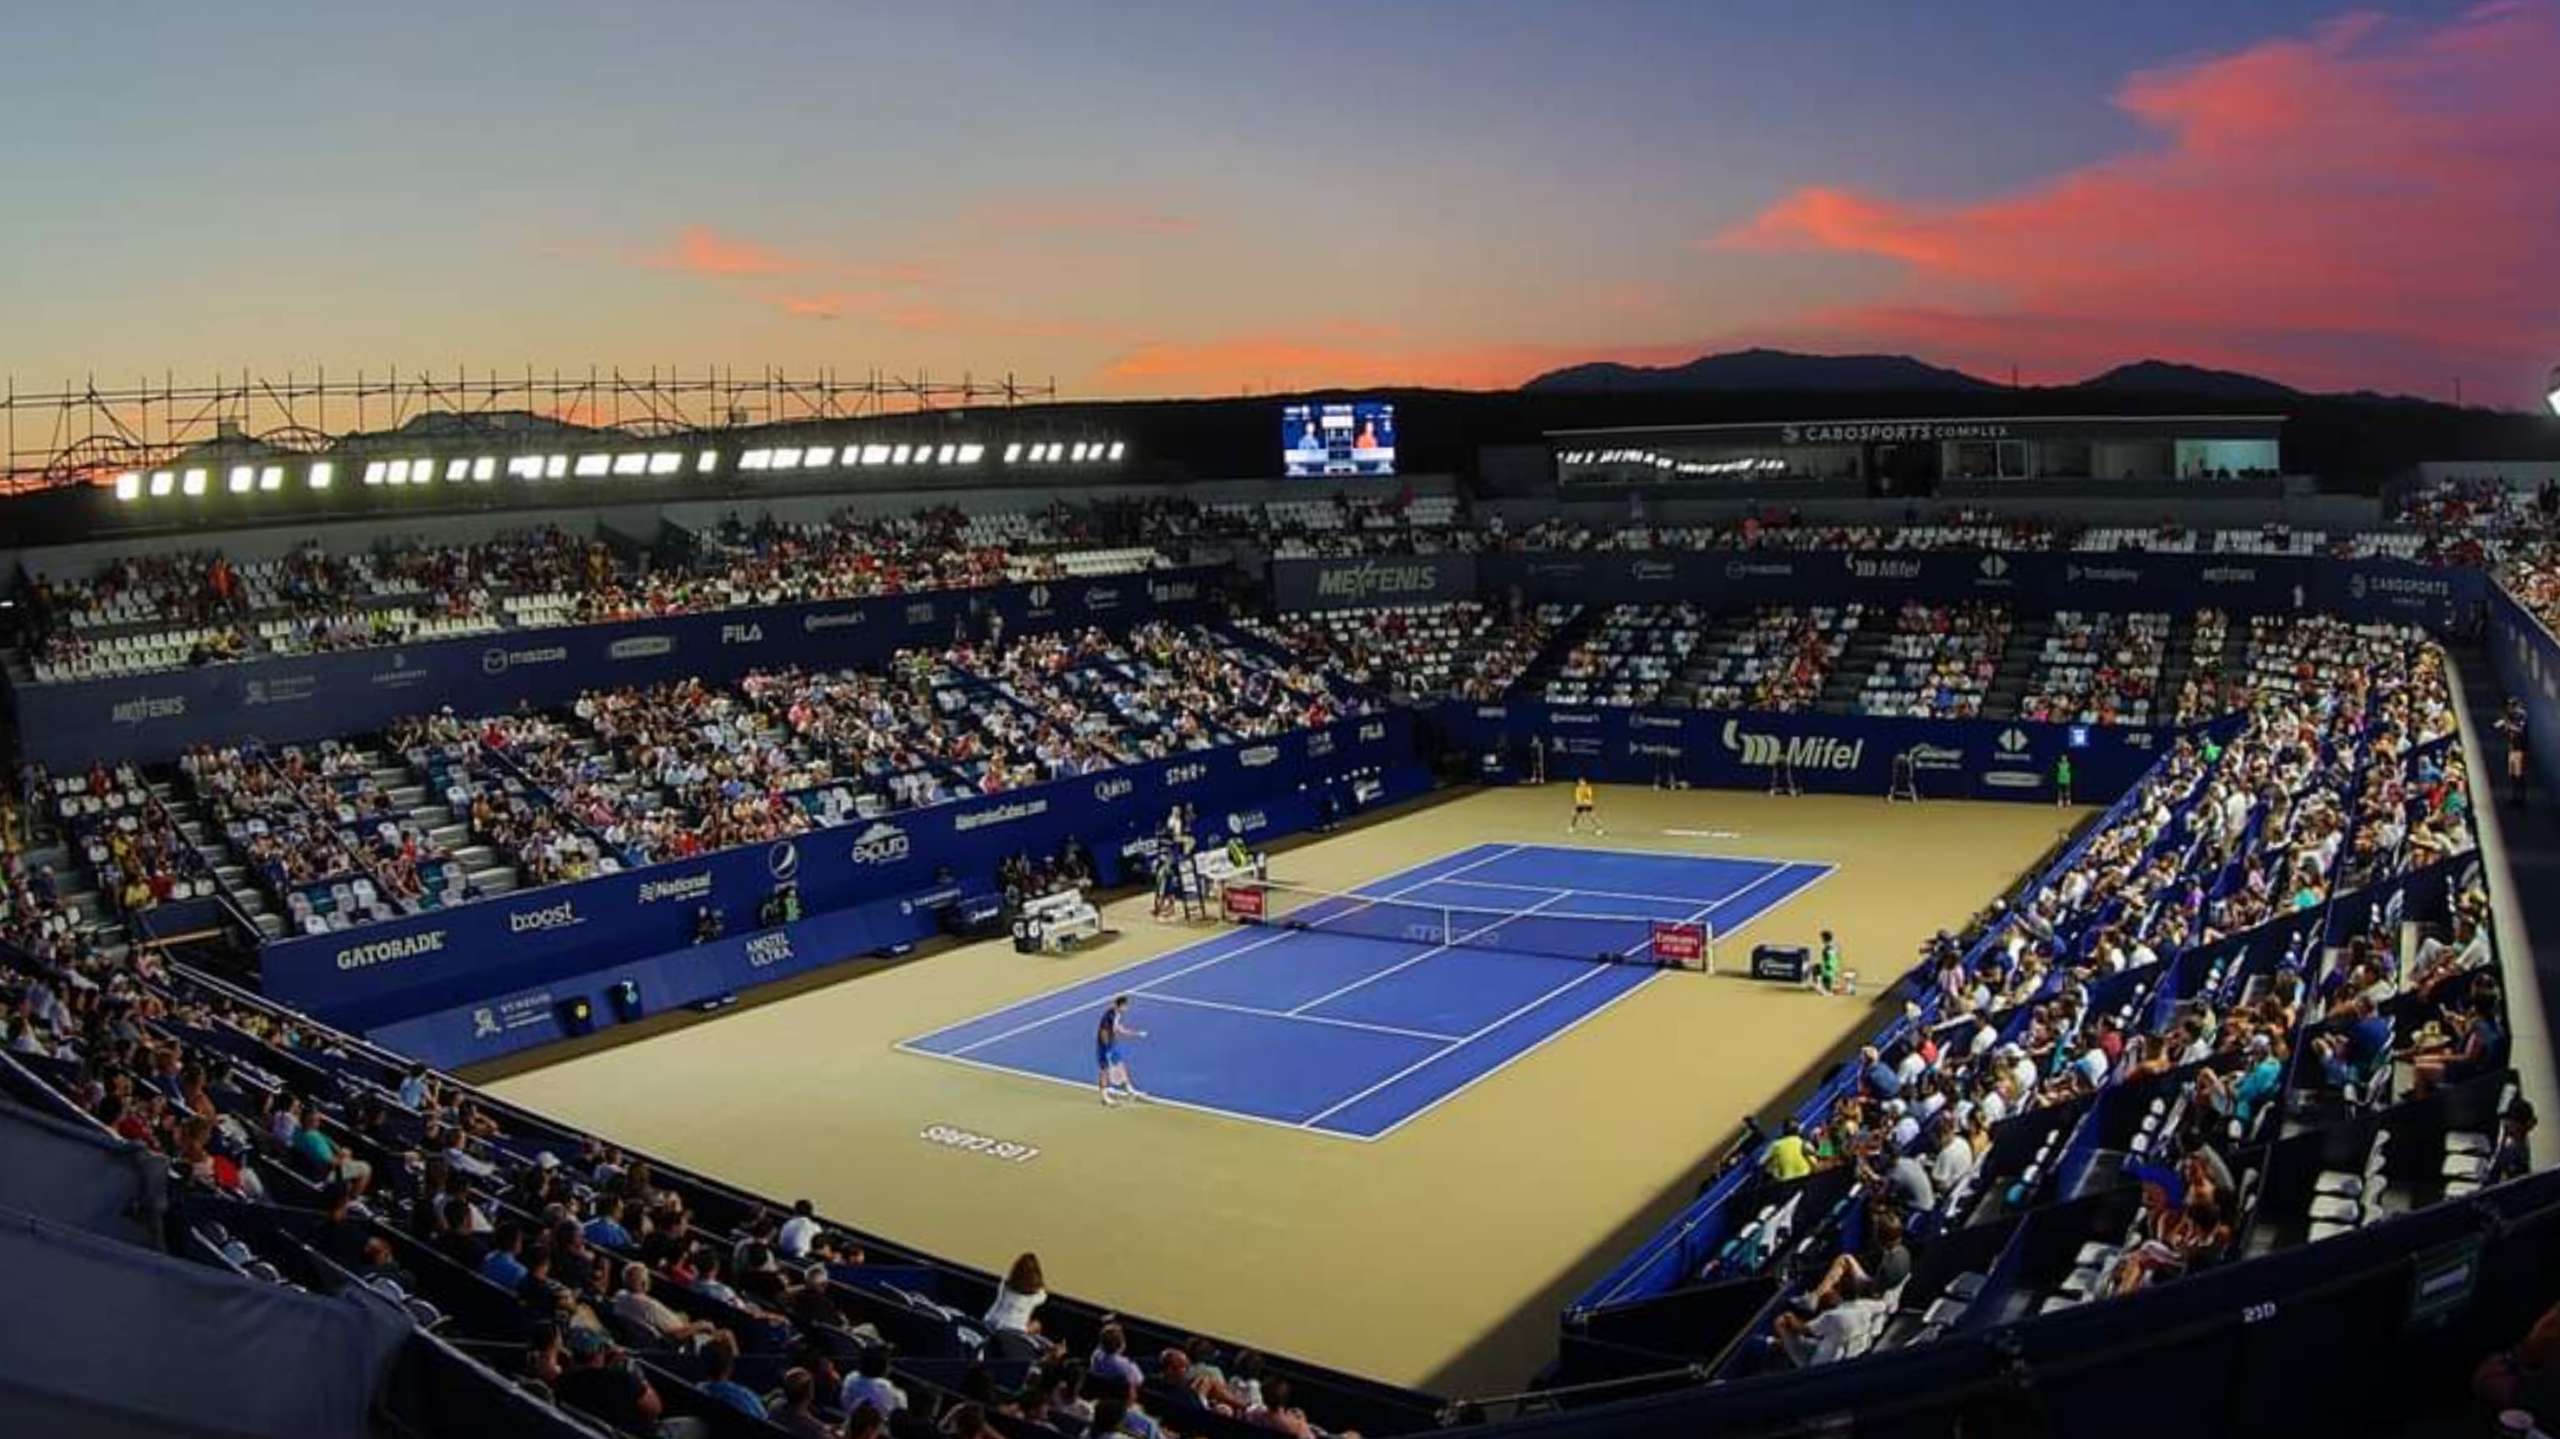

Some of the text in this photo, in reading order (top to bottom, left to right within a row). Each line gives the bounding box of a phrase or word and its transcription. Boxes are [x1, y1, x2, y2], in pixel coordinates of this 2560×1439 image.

[1805, 423, 1932, 443] CABOSPORTS
[1318, 561, 1437, 597] MEXTENIS
[722, 623, 763, 644] FILA
[1786, 736, 1864, 770] Mifel
[336, 931, 444, 970] GATORADE
